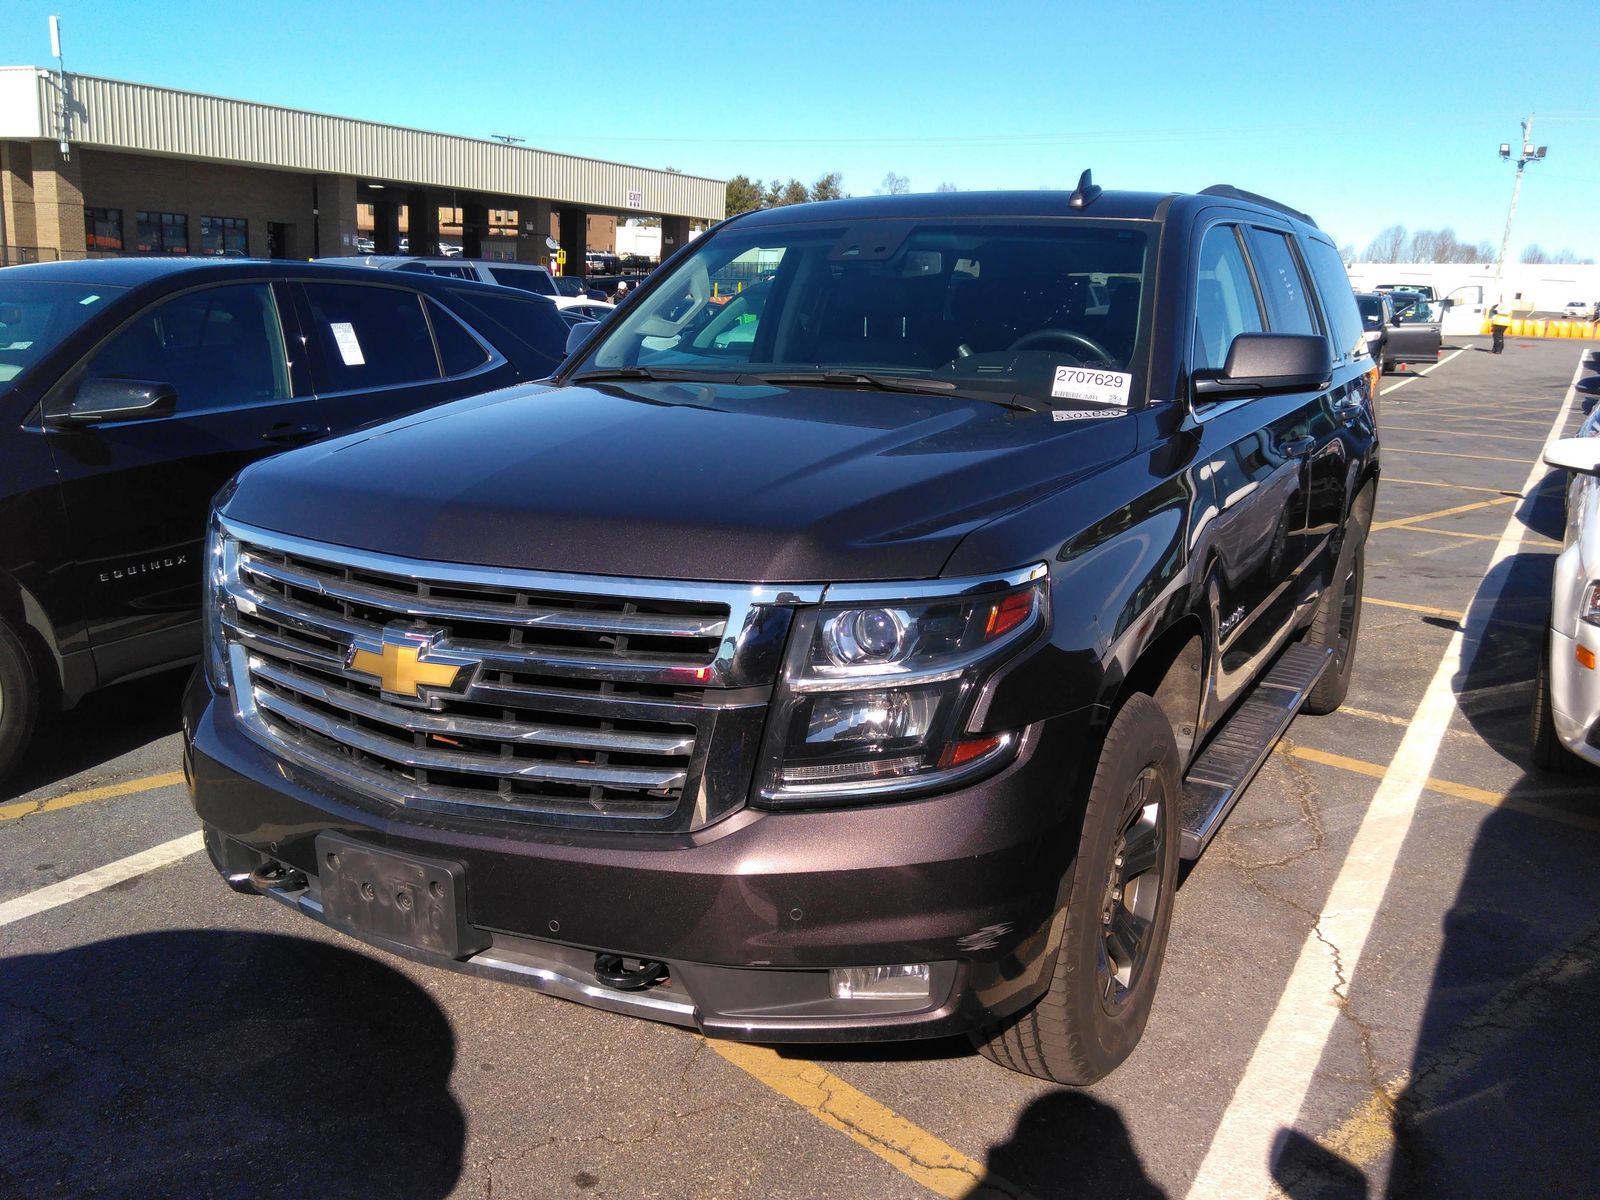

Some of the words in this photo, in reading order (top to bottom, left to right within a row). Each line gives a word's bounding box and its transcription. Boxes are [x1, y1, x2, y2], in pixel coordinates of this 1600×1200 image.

[629, 192, 641, 202] EXIT
[1056, 369, 1123, 388] 2707629
[99, 555, 187, 582] EQUINOX
